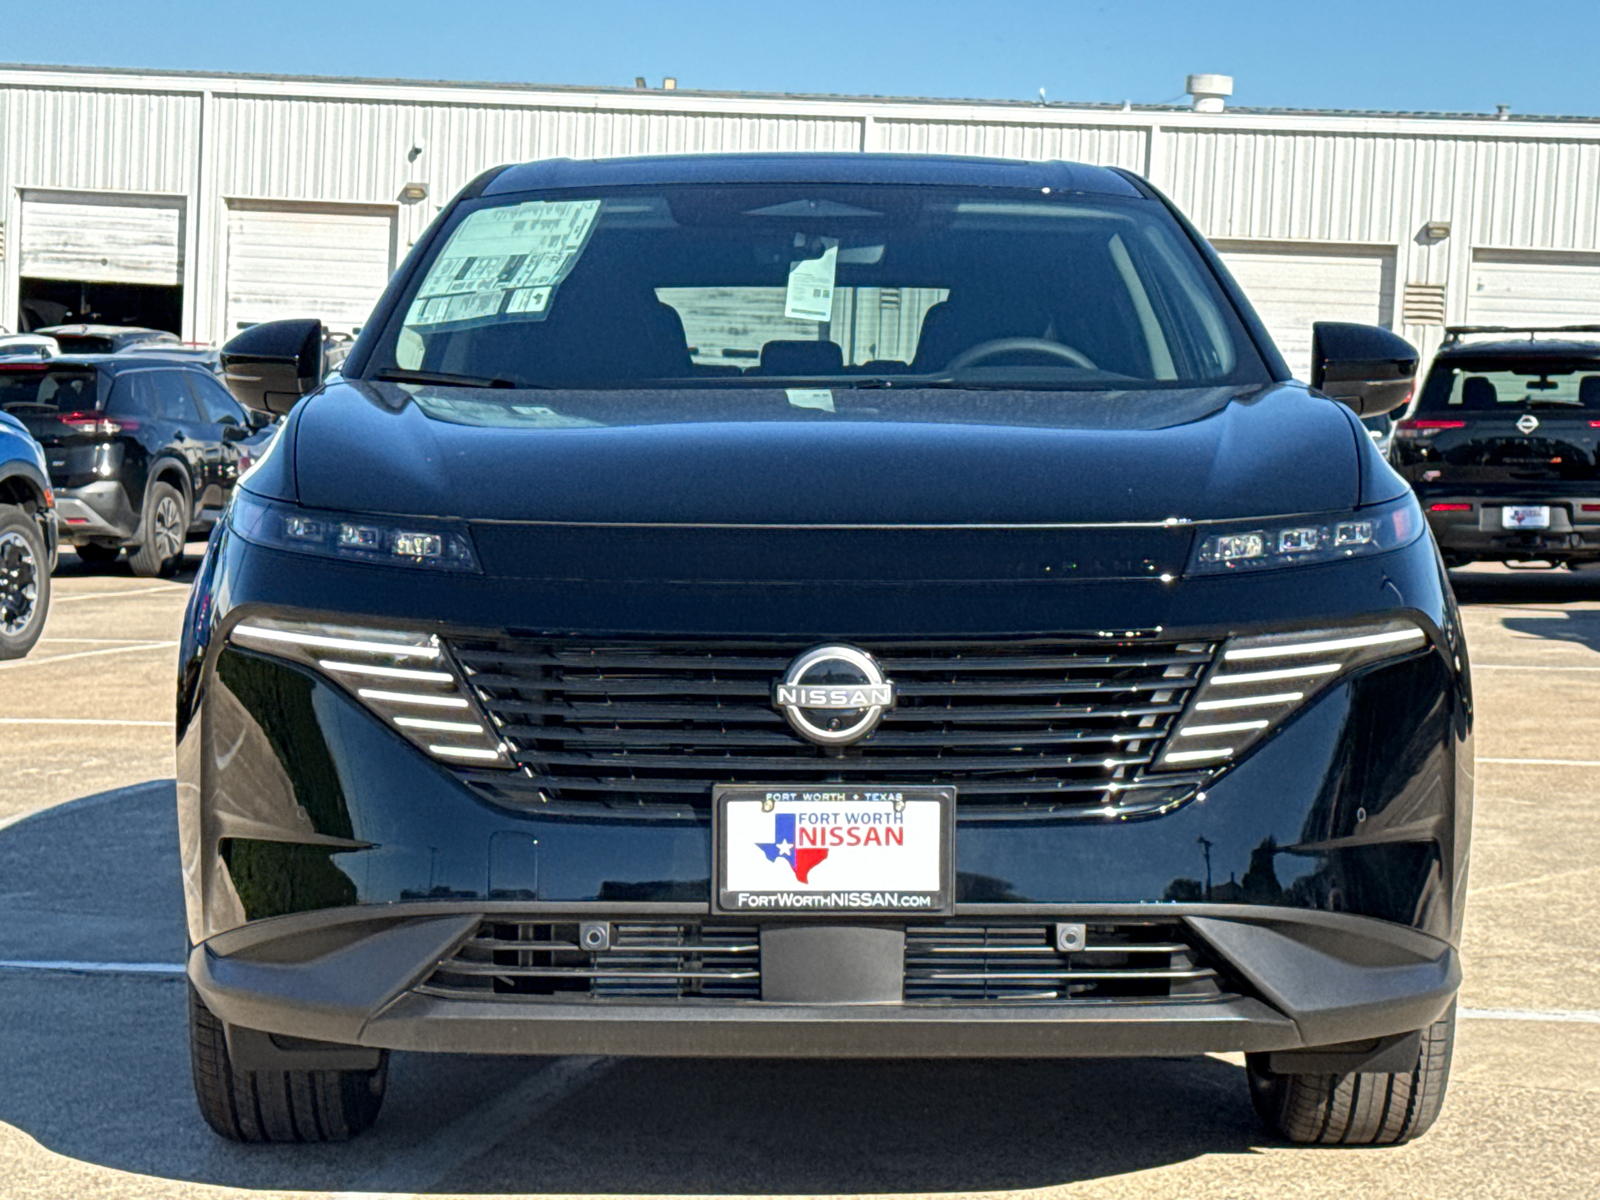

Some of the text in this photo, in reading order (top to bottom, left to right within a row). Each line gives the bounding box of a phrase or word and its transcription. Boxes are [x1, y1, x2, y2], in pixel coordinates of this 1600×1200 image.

[778, 687, 889, 705] NISSAN
[766, 792, 904, 801] FORT WORTH TEXAS
[799, 812, 904, 825] FORT WORTH
[798, 826, 904, 847] NISSAN
